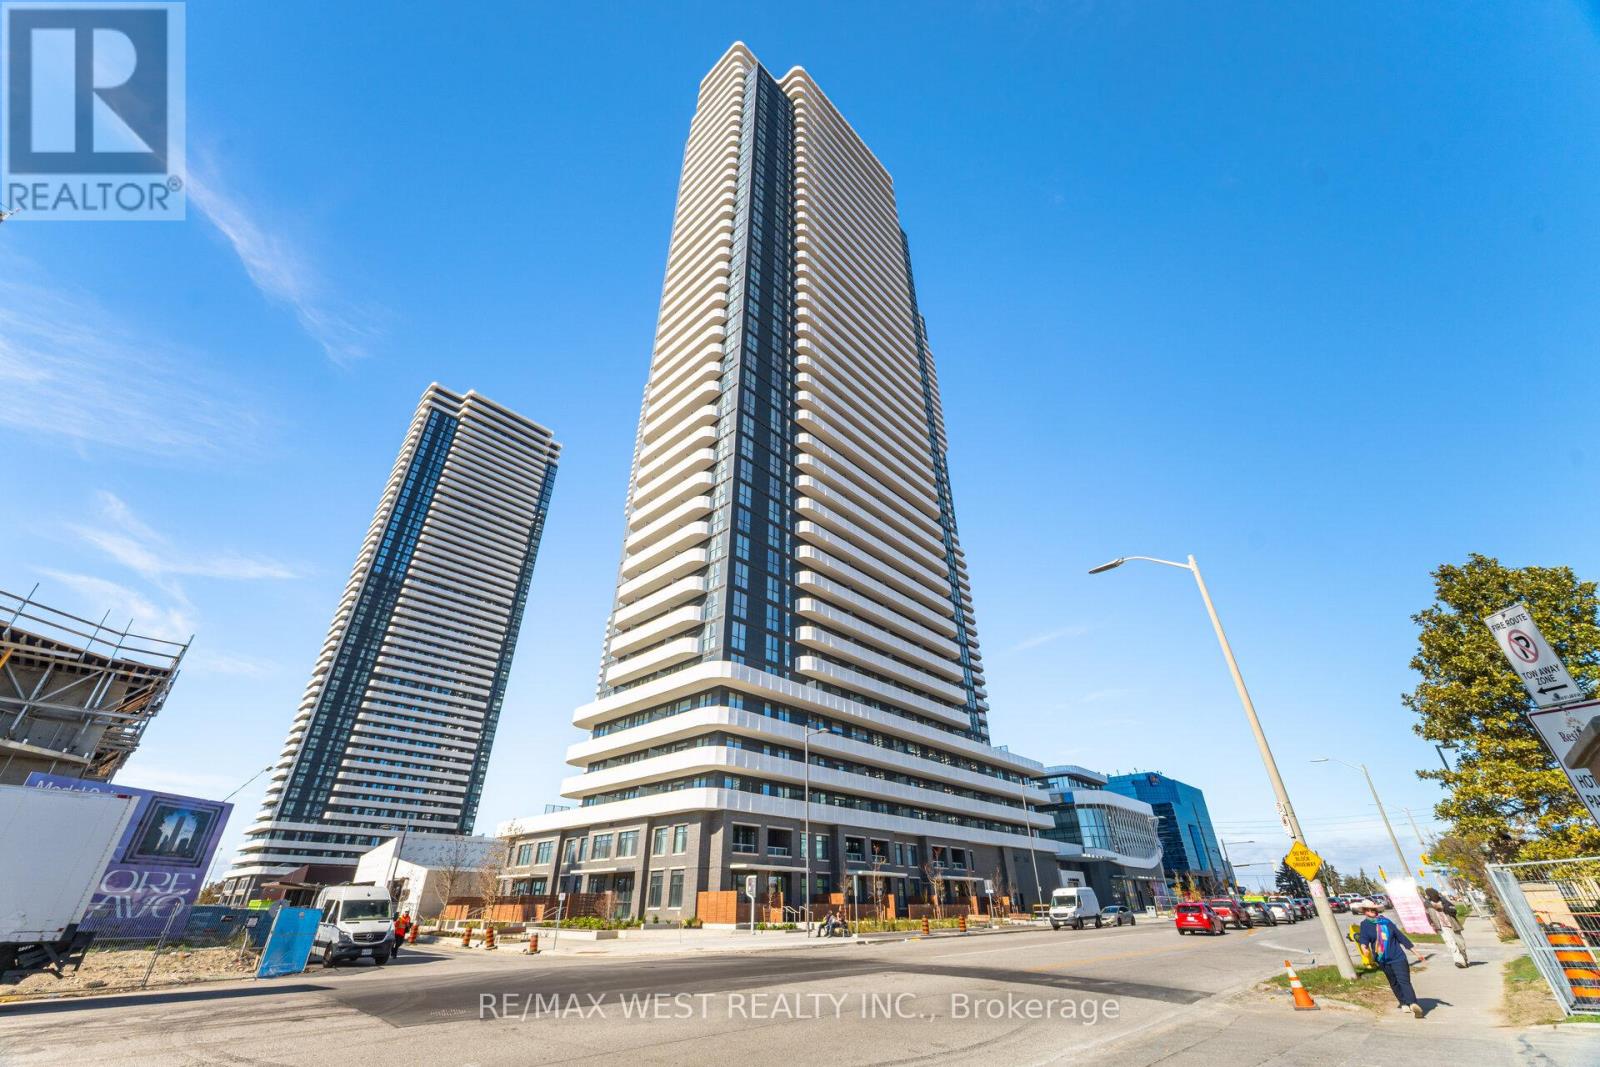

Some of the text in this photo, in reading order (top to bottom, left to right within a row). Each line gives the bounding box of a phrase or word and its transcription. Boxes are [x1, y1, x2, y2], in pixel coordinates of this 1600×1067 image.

[1491, 613, 1528, 632] FIRE ROUTE
[1521, 664, 1560, 680] TOW AWAY
[1535, 674, 1557, 686] ZONE
